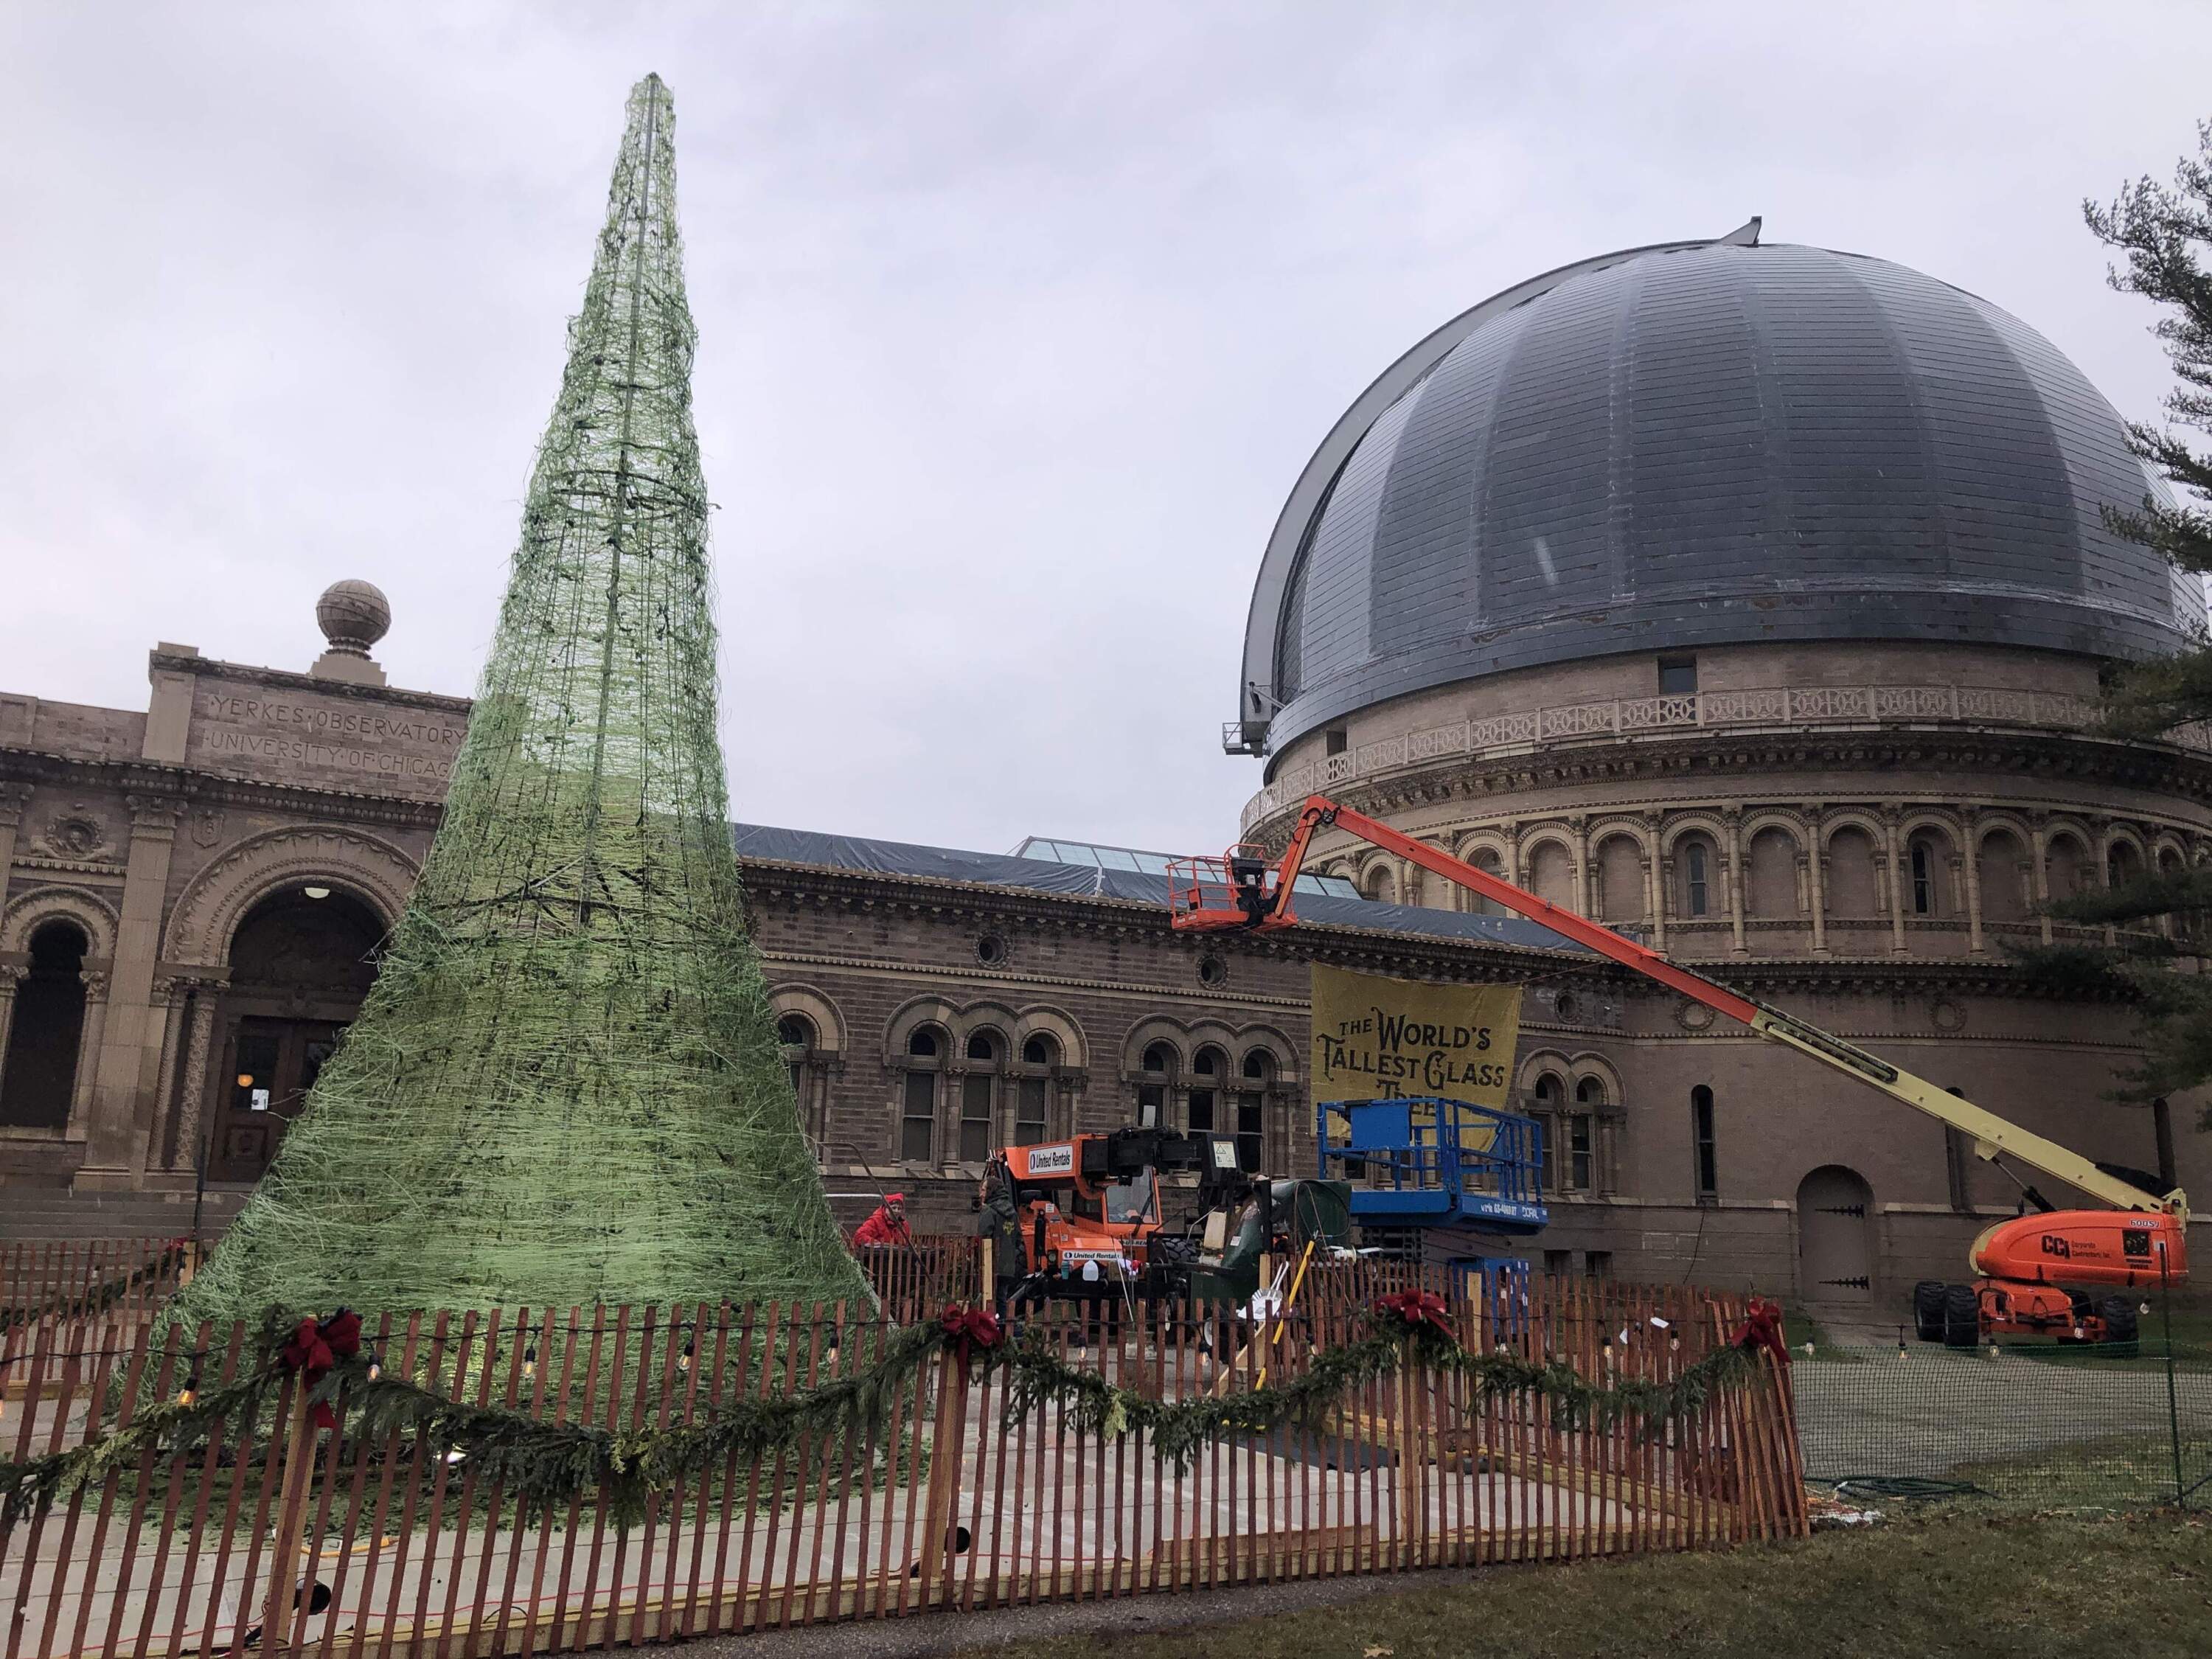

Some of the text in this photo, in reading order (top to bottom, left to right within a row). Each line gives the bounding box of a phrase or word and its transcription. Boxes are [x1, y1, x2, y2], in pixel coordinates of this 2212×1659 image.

[214, 695, 467, 745] YERKES OBSERVATORY
[211, 731, 449, 778] UNIVERSITY OF CHICAG
[1338, 1006, 1491, 1054] THE WORLD'S
[1316, 1033, 1505, 1091] TALLEST GLASS
[1036, 1150, 1071, 1168] United Rentals
[2130, 1220, 2160, 1228] 600SJ
